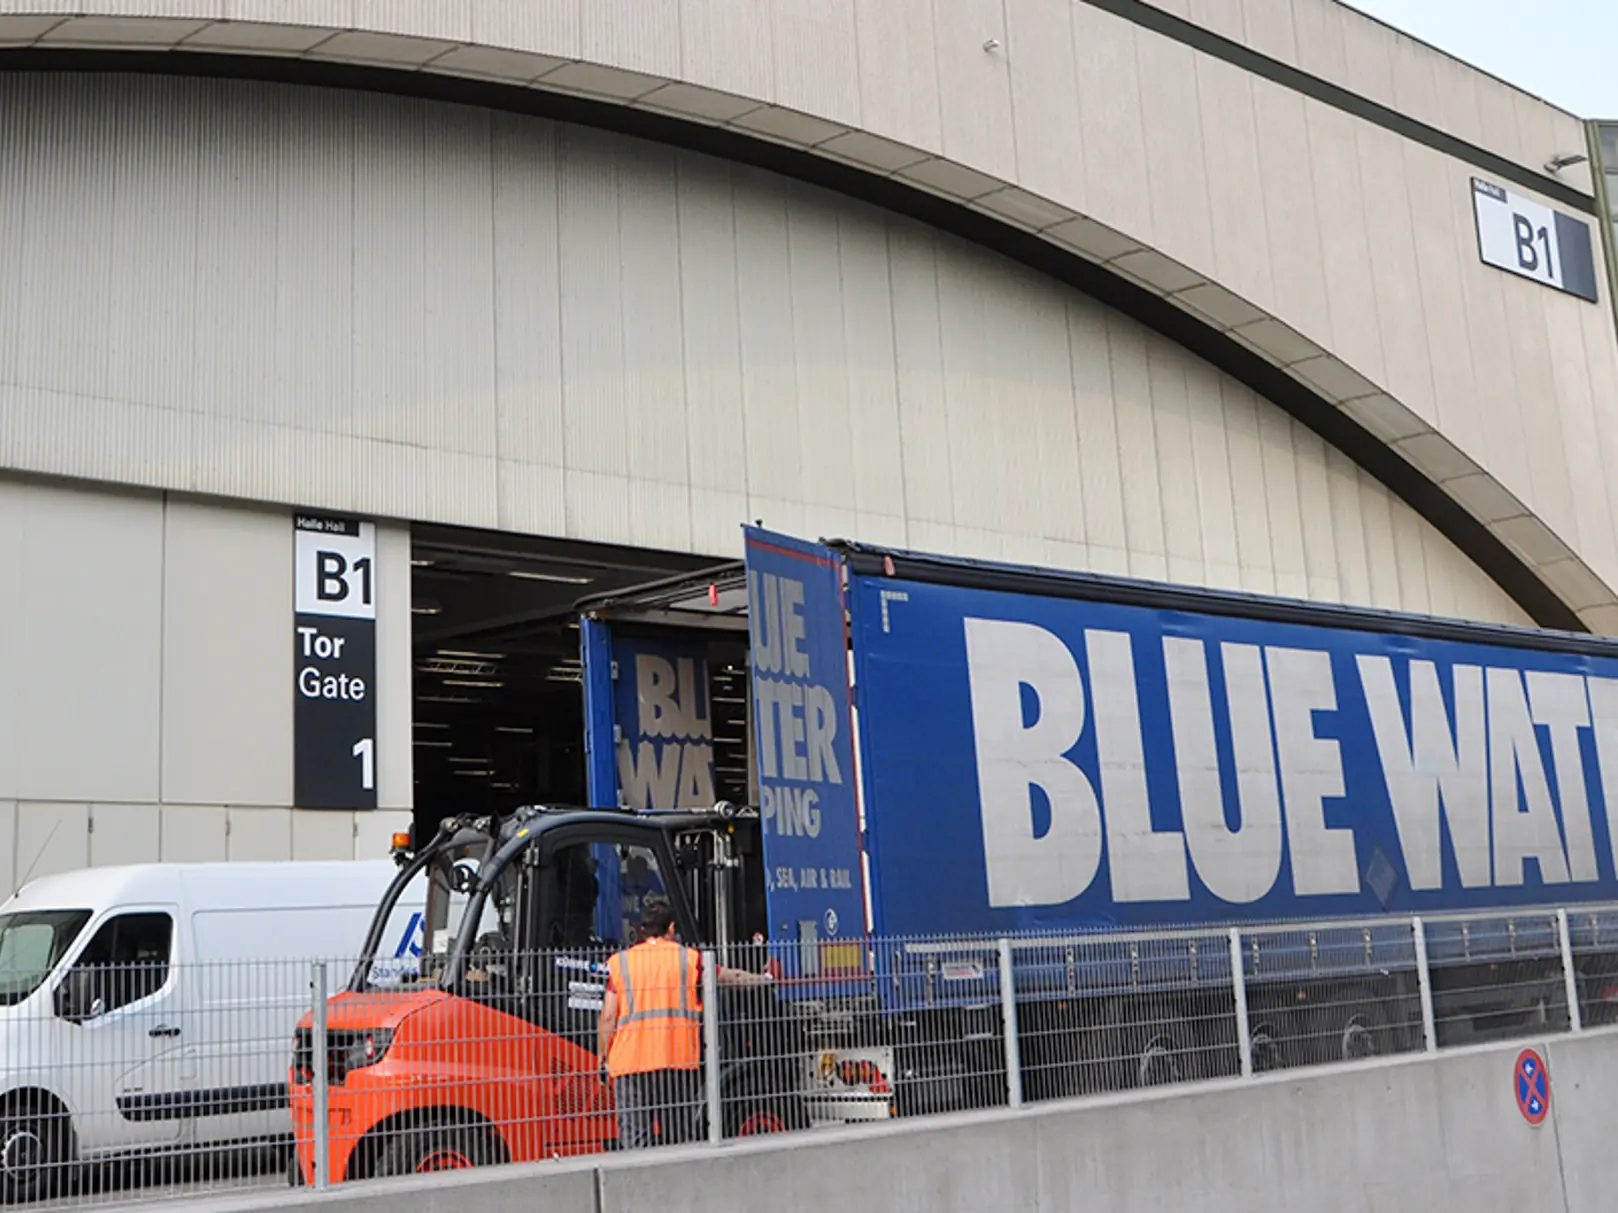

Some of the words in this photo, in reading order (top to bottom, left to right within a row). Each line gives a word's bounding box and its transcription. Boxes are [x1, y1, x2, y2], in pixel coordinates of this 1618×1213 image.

[1512, 211, 1553, 279] B1
[296, 517, 323, 530] Halle
[325, 520, 346, 532] Hall
[316, 550, 371, 605] B1
[297, 626, 345, 659] Tor
[298, 667, 366, 700] Gate
[352, 738, 374, 789] 1
[963, 616, 1361, 909] BLUE
